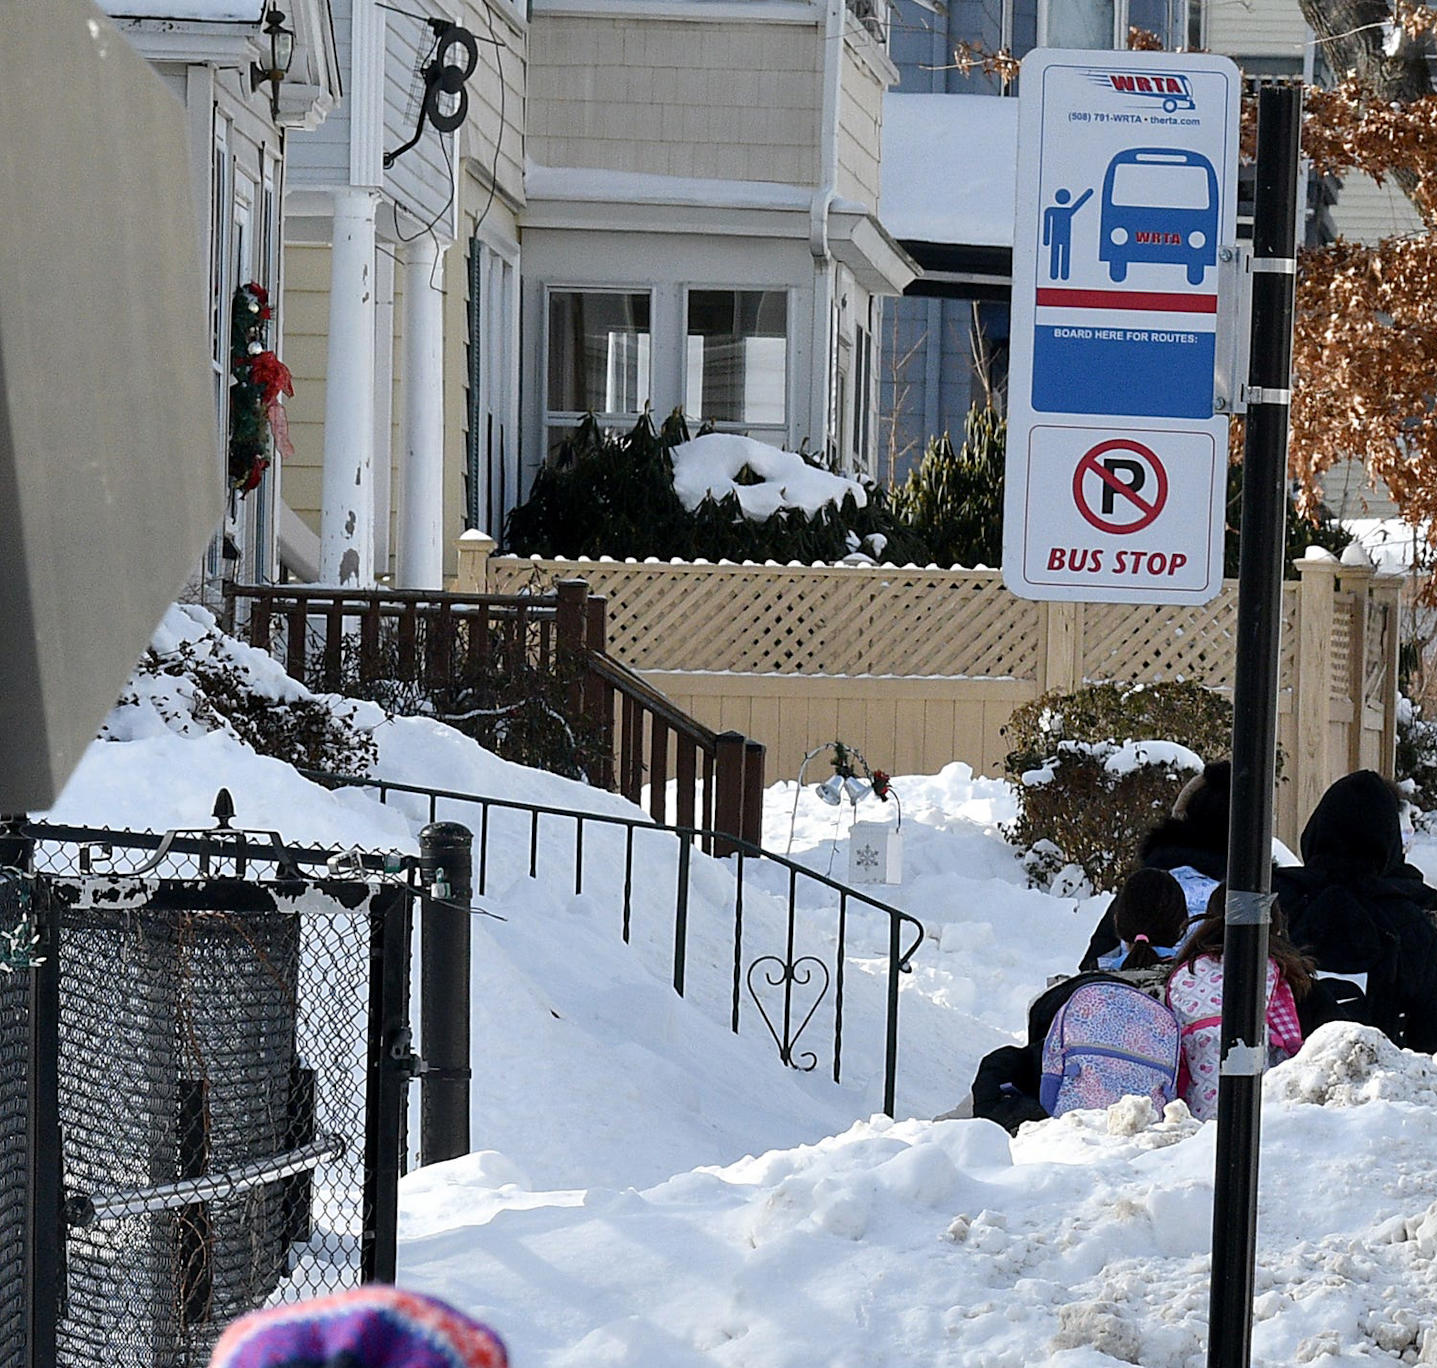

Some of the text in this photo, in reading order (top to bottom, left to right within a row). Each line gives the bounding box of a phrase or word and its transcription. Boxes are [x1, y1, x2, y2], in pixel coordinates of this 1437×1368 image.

[1109, 74, 1183, 94] WRTA
[1067, 112, 1200, 126] (508) 791-WRTA therta.com
[1135, 231, 1182, 245] WRTA
[1053, 328, 1198, 344] BOARD HERE FOR ROUTES:
[1101, 458, 1146, 515] P
[1047, 548, 1188, 576] BUS STOP
